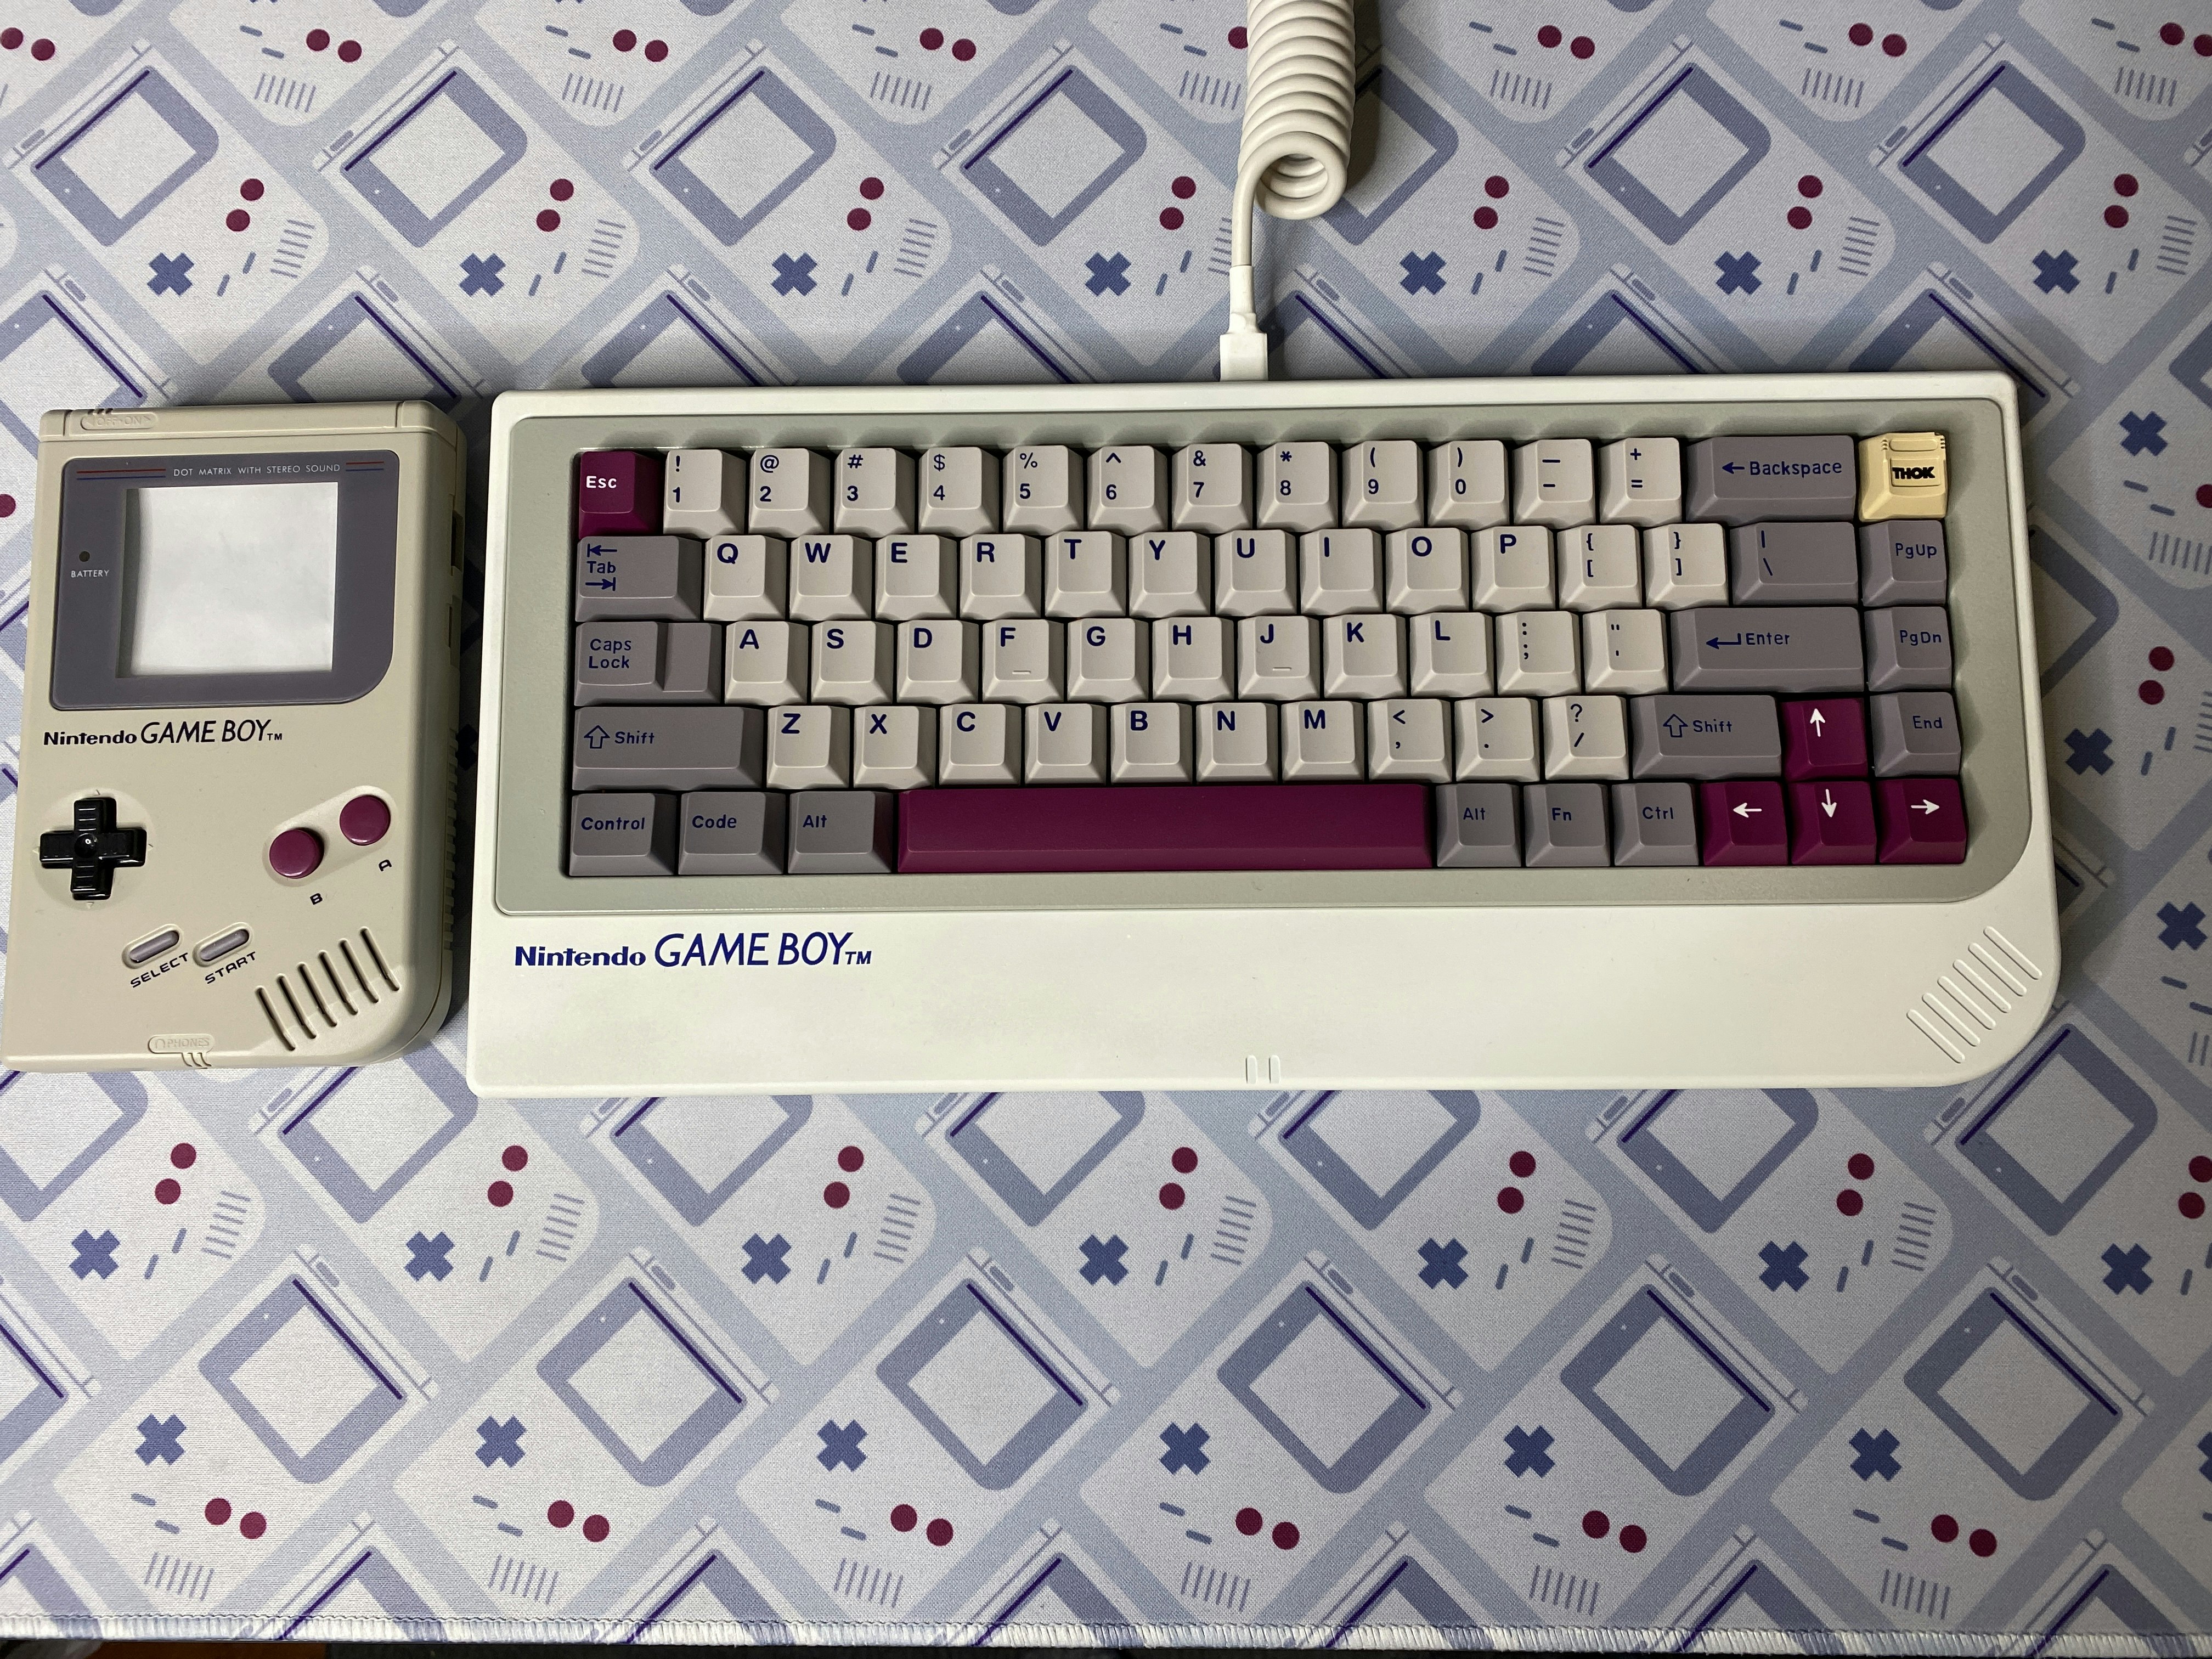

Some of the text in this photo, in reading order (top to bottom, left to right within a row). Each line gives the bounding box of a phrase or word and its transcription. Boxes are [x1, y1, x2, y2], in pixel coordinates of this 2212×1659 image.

[675, 455, 680, 472] !
[760, 454, 780, 473] @
[847, 454, 864, 469] #
[933, 453, 945, 472] $
[1019, 452, 1038, 469] %
[1193, 450, 1206, 467] &
[1370, 447, 1376, 468] (
[1457, 447, 1463, 468] )
[1630, 448, 1642, 461] +
[173, 468, 193, 476] DOT
[266, 465, 301, 473] STEREO
[306, 464, 340, 472] SOUND
[1750, 461, 1842, 478] Backspace
[1892, 466, 1935, 479] THOK
[586, 476, 617, 489] Esc
[1019, 483, 1031, 499] 5
[1193, 481, 1205, 498] 7
[1280, 479, 1291, 496] 8
[1368, 478, 1379, 495] 9
[1630, 479, 1643, 488] =
[672, 487, 680, 503] 1
[759, 486, 772, 502] 2
[847, 485, 859, 501] 3
[933, 484, 945, 501] 4
[1105, 484, 1117, 500] 6
[1063, 539, 1082, 560] T
[1237, 538, 1255, 558] U
[1324, 537, 1330, 557] I
[1411, 536, 1432, 557] O
[1500, 534, 1517, 554] P
[1586, 533, 1594, 551] {
[1673, 531, 1681, 550] }
[716, 543, 738, 565] Q
[805, 542, 831, 563] W
[891, 542, 908, 563] E
[977, 541, 995, 563] R
[1149, 539, 1166, 561] Y
[1895, 543, 1937, 559] PgUp
[71, 569, 110, 578] BATTERY
[586, 561, 616, 574] Tab
[1587, 559, 1594, 578] [
[1675, 558, 1682, 576] ]
[739, 629, 759, 650] A
[826, 628, 844, 649] S
[913, 627, 933, 648] D
[1000, 627, 1016, 647] F
[1086, 626, 1106, 647] G
[1172, 624, 1192, 646] H
[1260, 623, 1274, 644] J
[1346, 622, 1364, 643] K
[1435, 620, 1451, 641] L
[1746, 632, 1790, 645] Enter
[1899, 629, 1942, 646] PgDn
[589, 638, 631, 657] Caps
[588, 655, 630, 669] Lock
[956, 711, 976, 732] C
[1043, 711, 1062, 732] V
[1130, 710, 1148, 731] B
[1217, 710, 1235, 731] N
[1304, 709, 1326, 730] M
[1392, 709, 1406, 725] <
[1481, 708, 1494, 724] >
[1570, 703, 1583, 723] ?
[1912, 715, 1943, 729] End
[43, 731, 137, 746] Nintendo
[140, 720, 216, 744] GAME
[221, 719, 271, 742] BOY
[781, 713, 801, 734] Z
[869, 714, 887, 735] X
[1692, 719, 1733, 732] Shift
[614, 730, 655, 744] Shift
[692, 814, 737, 829] Code
[802, 815, 827, 828] Alt
[1463, 807, 1486, 821] Alt
[1551, 807, 1572, 821] Fn
[1642, 806, 1674, 820] Ctrl
[581, 817, 645, 831] Control
[378, 859, 392, 872] A
[309, 893, 323, 905] B
[515, 946, 646, 967] Nintendo
[654, 933, 769, 967] GAME
[777, 931, 854, 966] BOY
[131, 952, 188, 988] SELECT
[205, 951, 256, 984] START
[167, 1037, 210, 1047] PHONES
